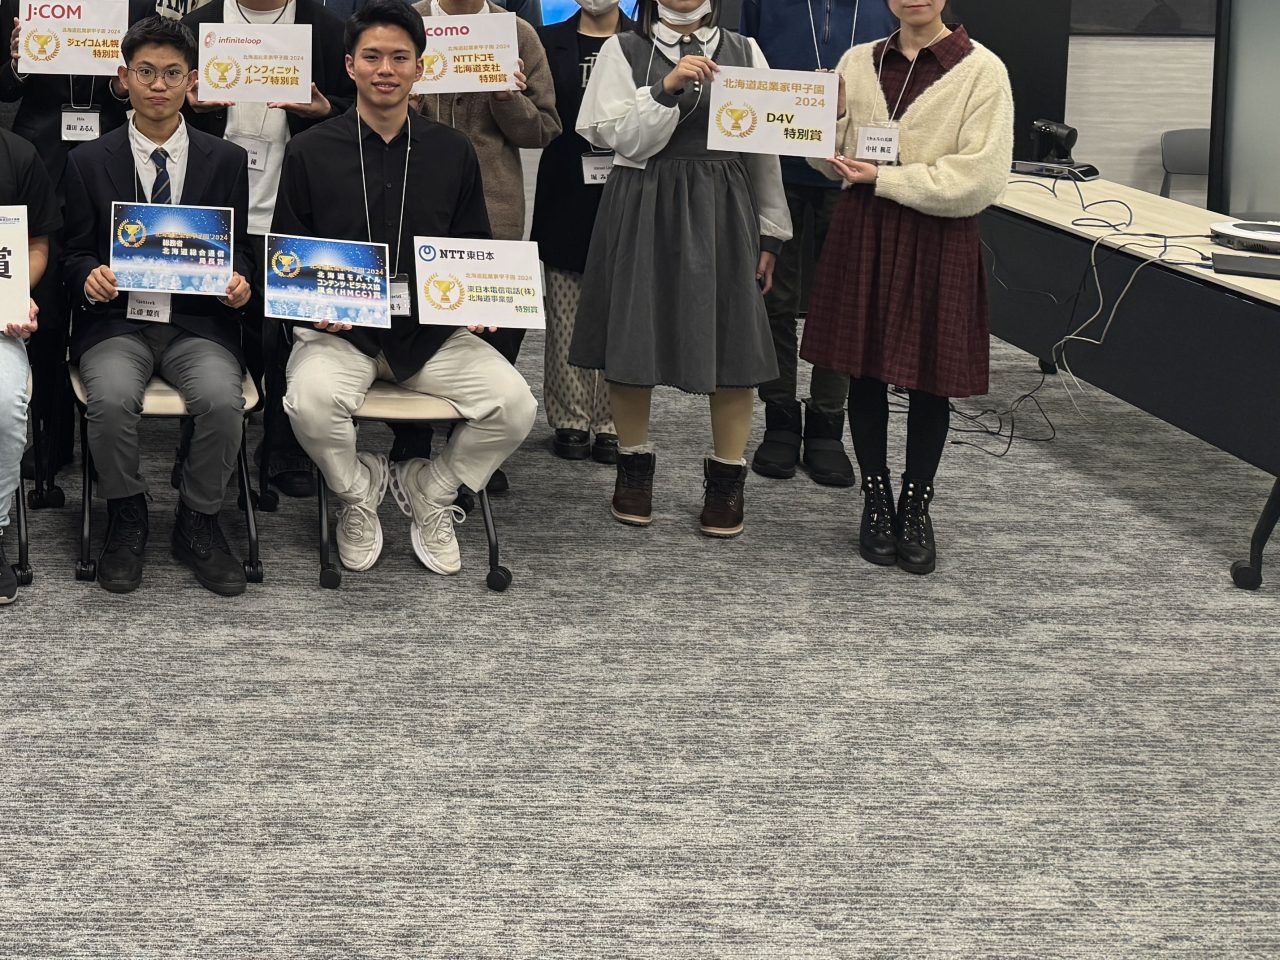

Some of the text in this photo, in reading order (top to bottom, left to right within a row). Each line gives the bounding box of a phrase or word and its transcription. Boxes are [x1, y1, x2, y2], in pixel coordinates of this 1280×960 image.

[25, 4, 81, 21] J:COM
[218, 36, 262, 45] infiniteloop
[92, 50, 119, 58] 特別賞
[453, 53, 494, 62] NTTドコモ
[245, 65, 300, 75] インフィニット
[453, 64, 500, 73] 北海道支社
[245, 76, 300, 85] ループ特別賞
[479, 74, 507, 83] 特別賞
[723, 78, 825, 94] 北海道起業家甲子園
[794, 97, 826, 107] 2024
[766, 113, 794, 124] D4V
[784, 128, 822, 141] 特別賞
